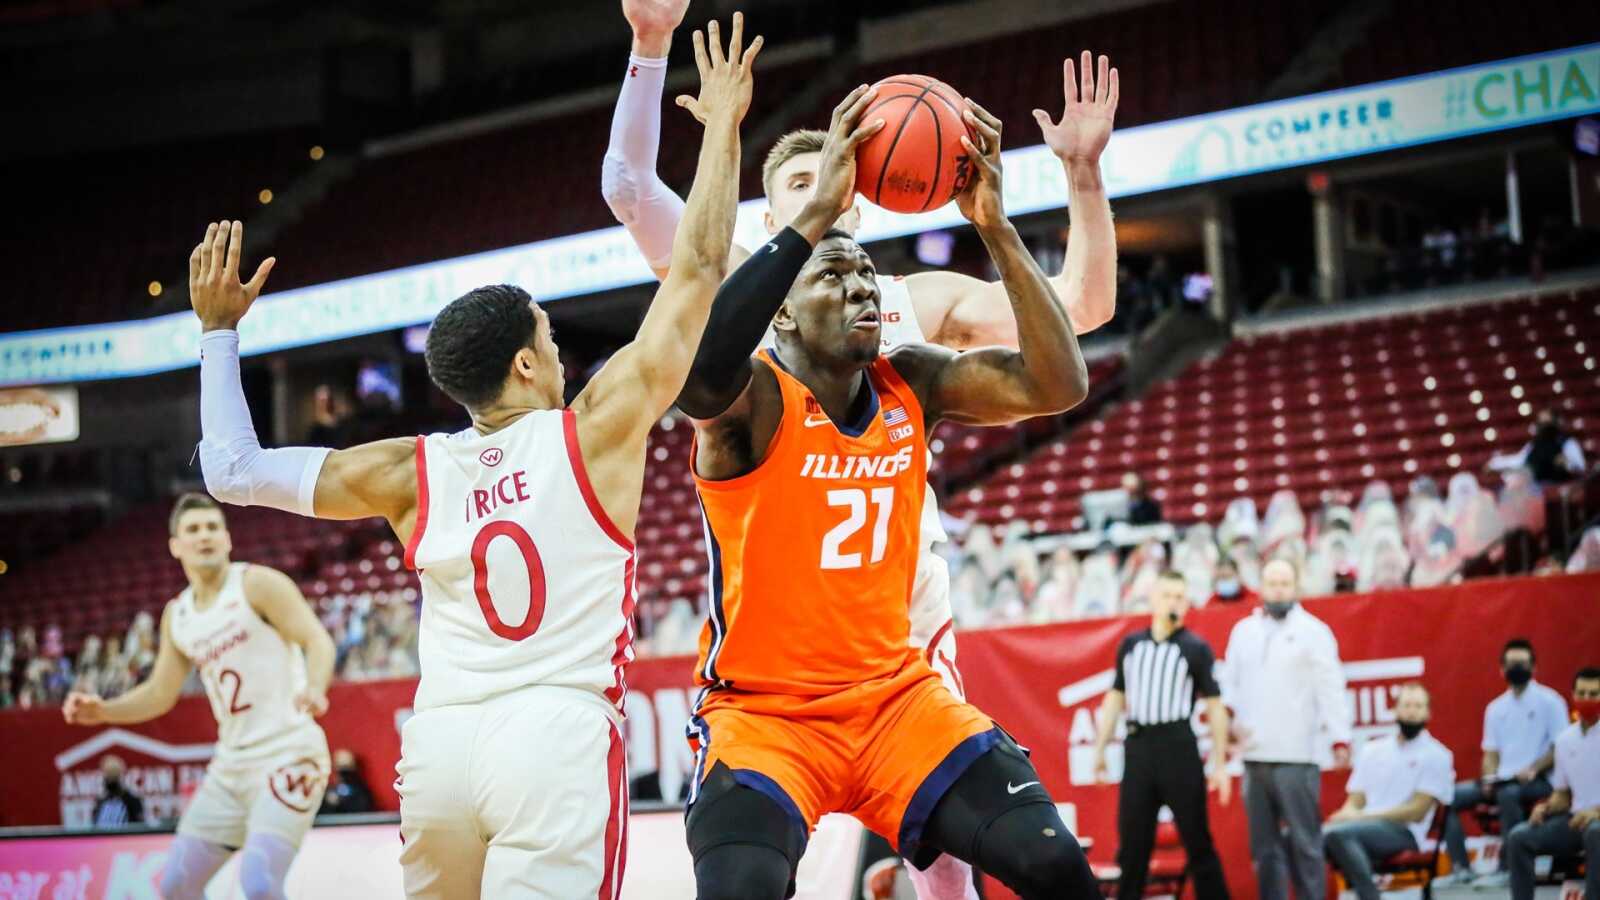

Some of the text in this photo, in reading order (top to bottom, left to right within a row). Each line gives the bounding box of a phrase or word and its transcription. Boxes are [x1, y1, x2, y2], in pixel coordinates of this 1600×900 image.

[1445, 57, 1600, 119] #CHA
[1244, 98, 1394, 146] COMPEER
[800, 445, 914, 479] ILLINOS
[819, 486, 895, 570] 21
[470, 520, 547, 642] 0
